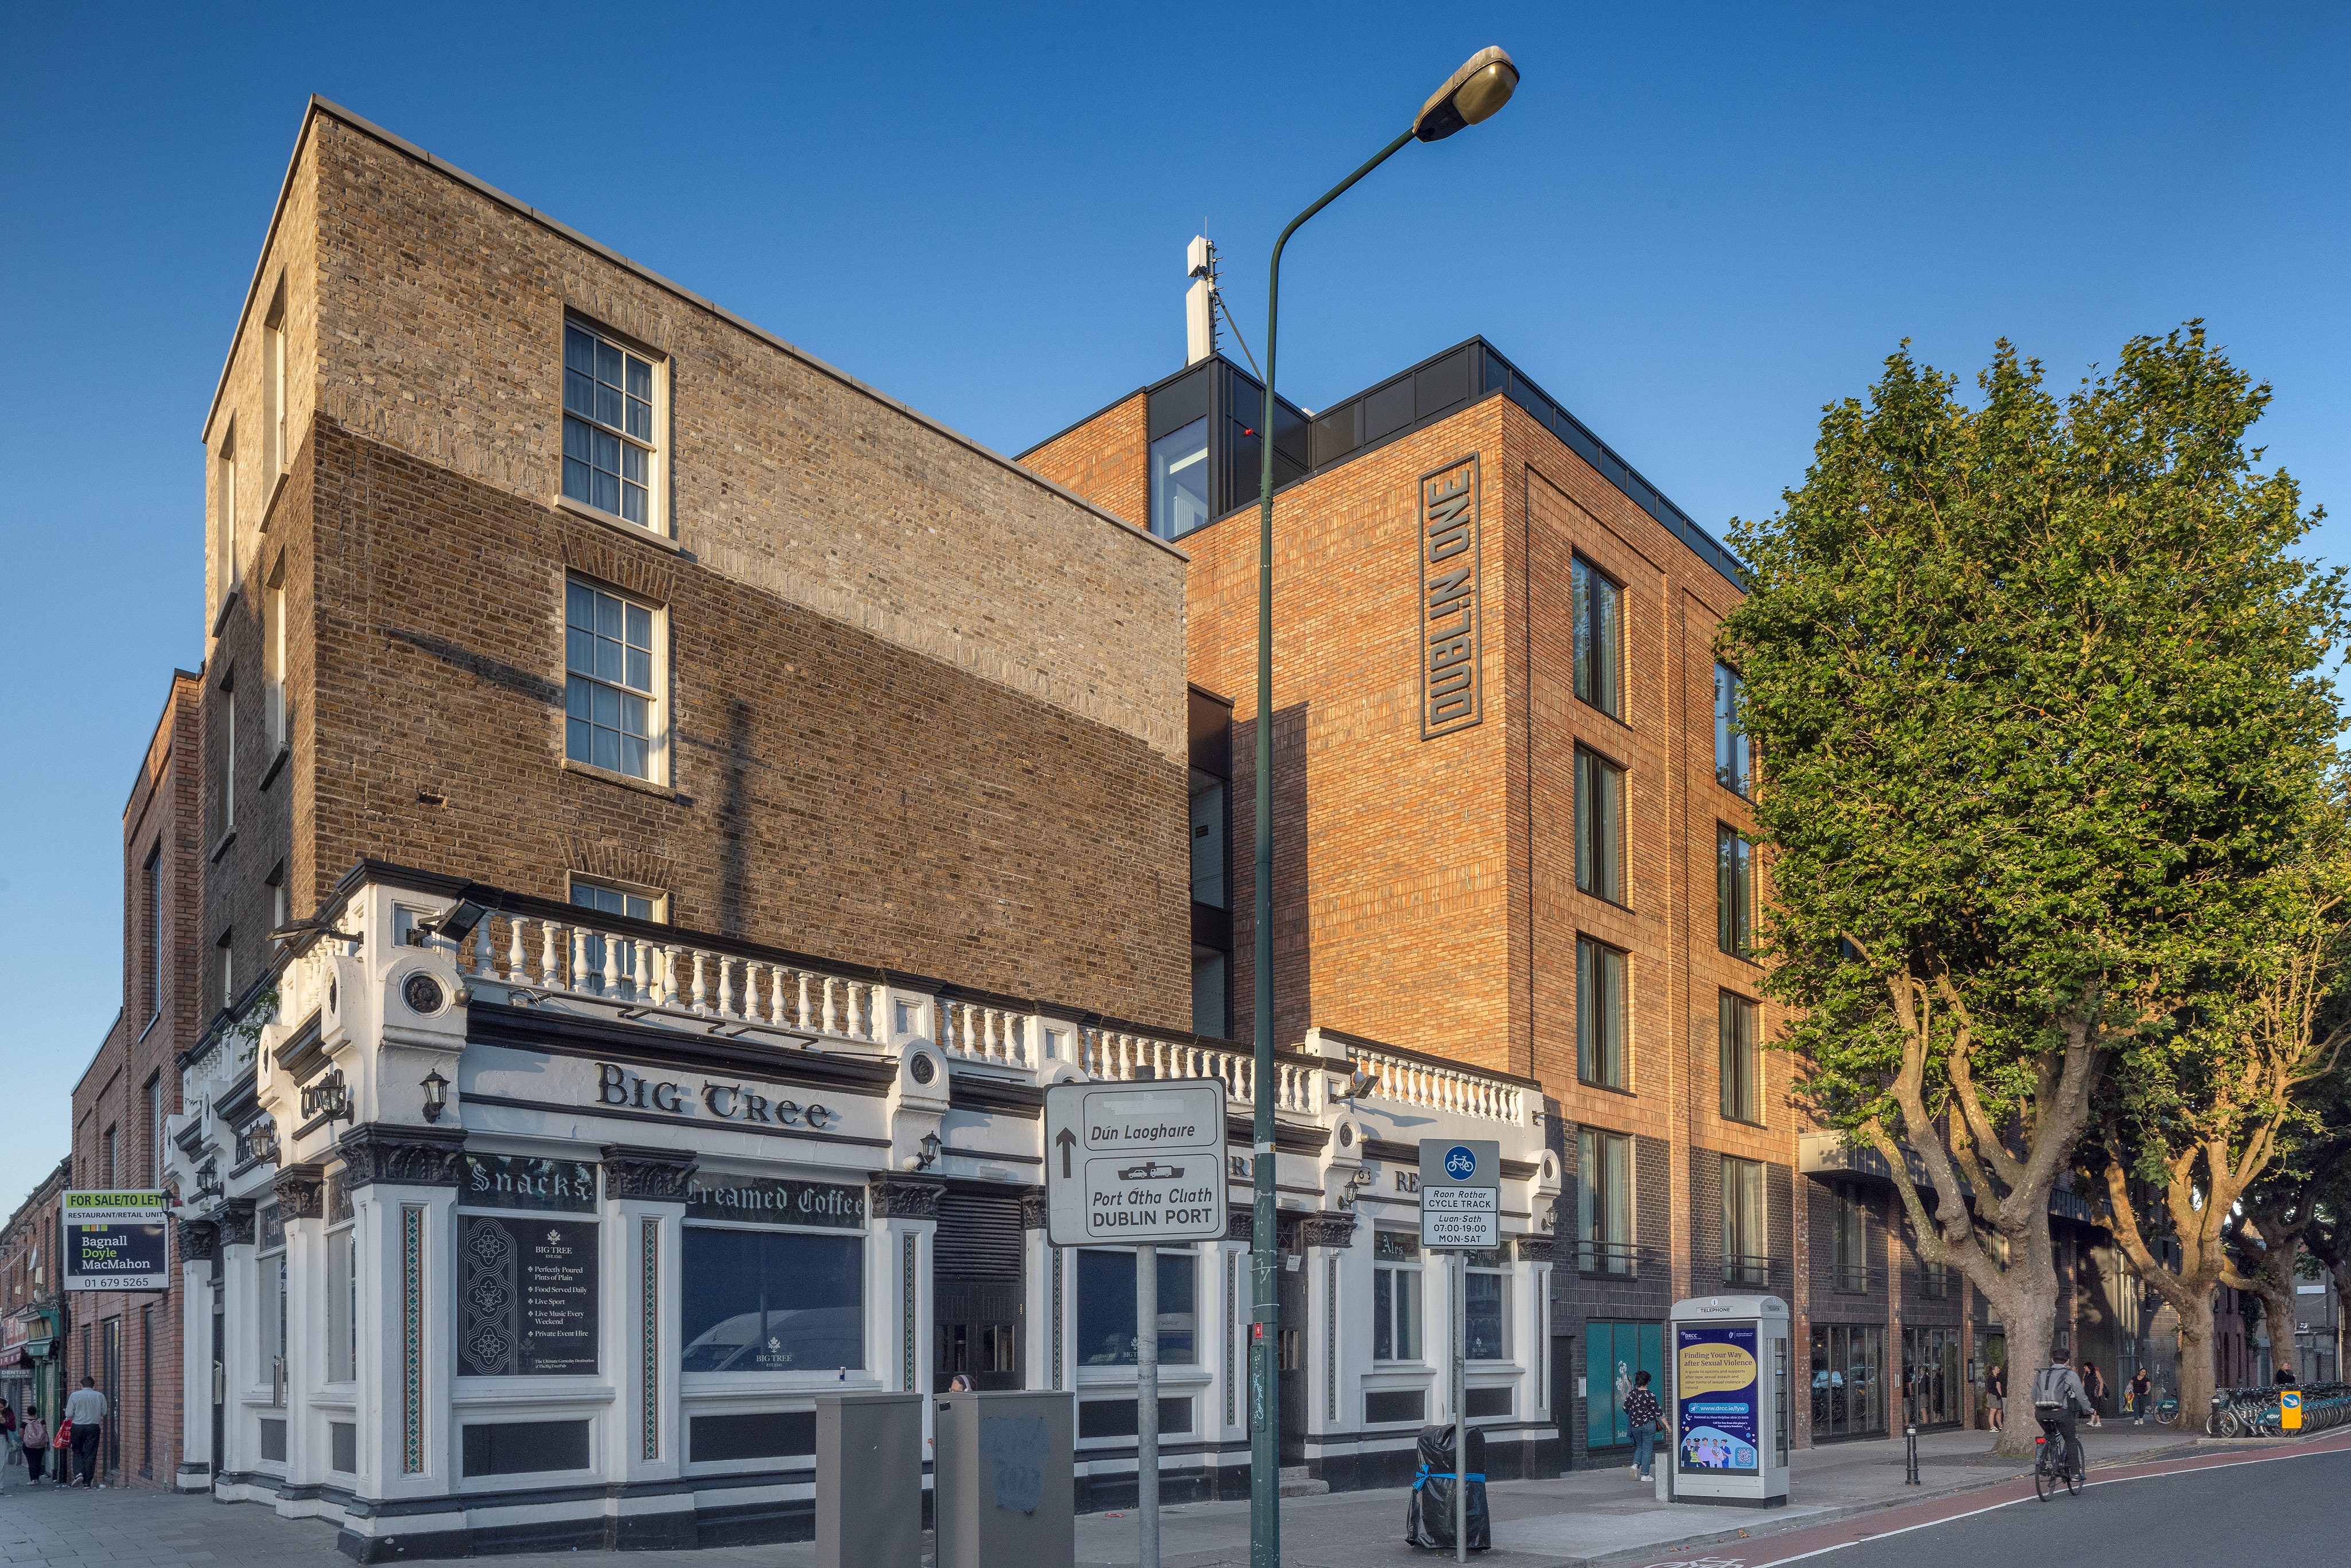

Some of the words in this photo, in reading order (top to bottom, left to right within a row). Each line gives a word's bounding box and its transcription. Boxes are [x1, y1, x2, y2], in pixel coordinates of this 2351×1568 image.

[1428, 469, 1470, 564] ONE
[1429, 566, 1471, 725] DUBLIN
[1091, 1125, 1119, 1140] Dún
[71, 1195, 91, 1206] FOR
[95, 1195, 138, 1206] SALE/TO
[141, 1195, 159, 1205] LET
[798, 1188, 864, 1215] Coffee
[1092, 1191, 1123, 1206] Port
[1461, 1200, 1491, 1208] TRACK
[1093, 1210, 1157, 1227] DUBLIN
[1165, 1208, 1212, 1224] PORT
[1434, 1224, 1487, 1232] 07:00-19:00
[82, 1236, 127, 1249] Bagnall
[82, 1248, 117, 1260] Doyle
[82, 1259, 150, 1270] MacMahon
[535, 1266, 561, 1274] Perfectly
[84, 1279, 96, 1287] 01
[100, 1279, 119, 1287] 679
[123, 1278, 149, 1286] 5265
[572, 1287, 587, 1295] Daily
[567, 1310, 584, 1318] Every
